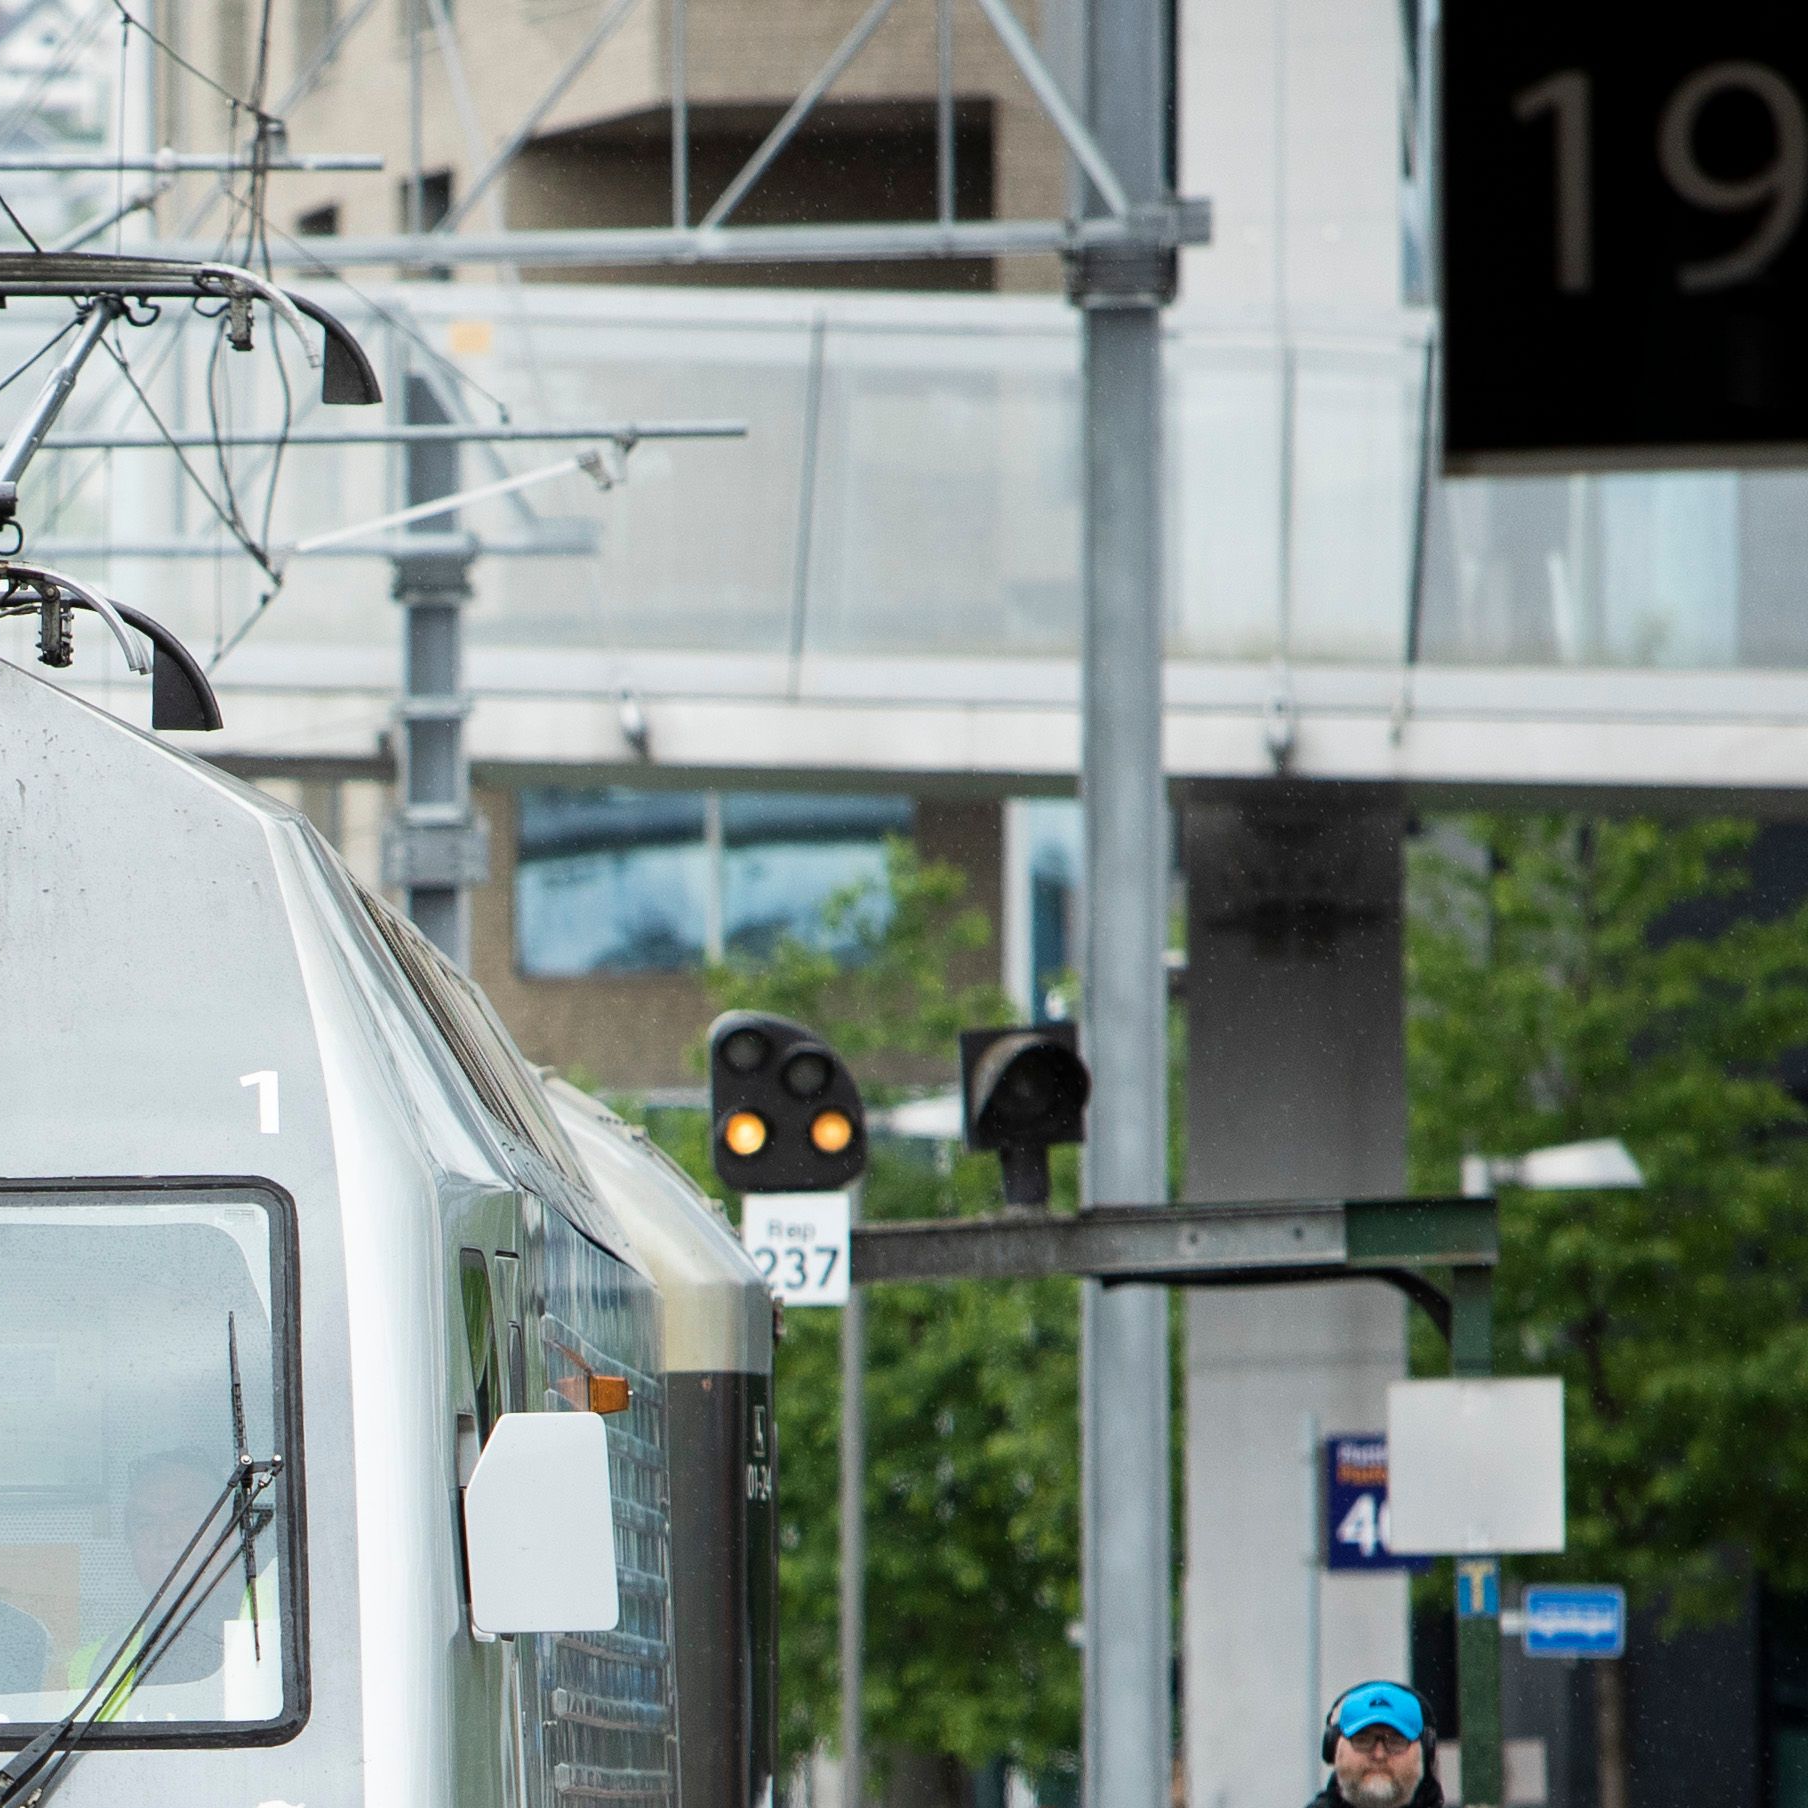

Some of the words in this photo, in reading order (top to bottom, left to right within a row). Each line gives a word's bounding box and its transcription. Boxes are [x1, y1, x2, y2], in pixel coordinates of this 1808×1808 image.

[1512, 62, 1808, 292] 19
[240, 1070, 279, 1134] 1
[755, 1246, 838, 1290] 237
